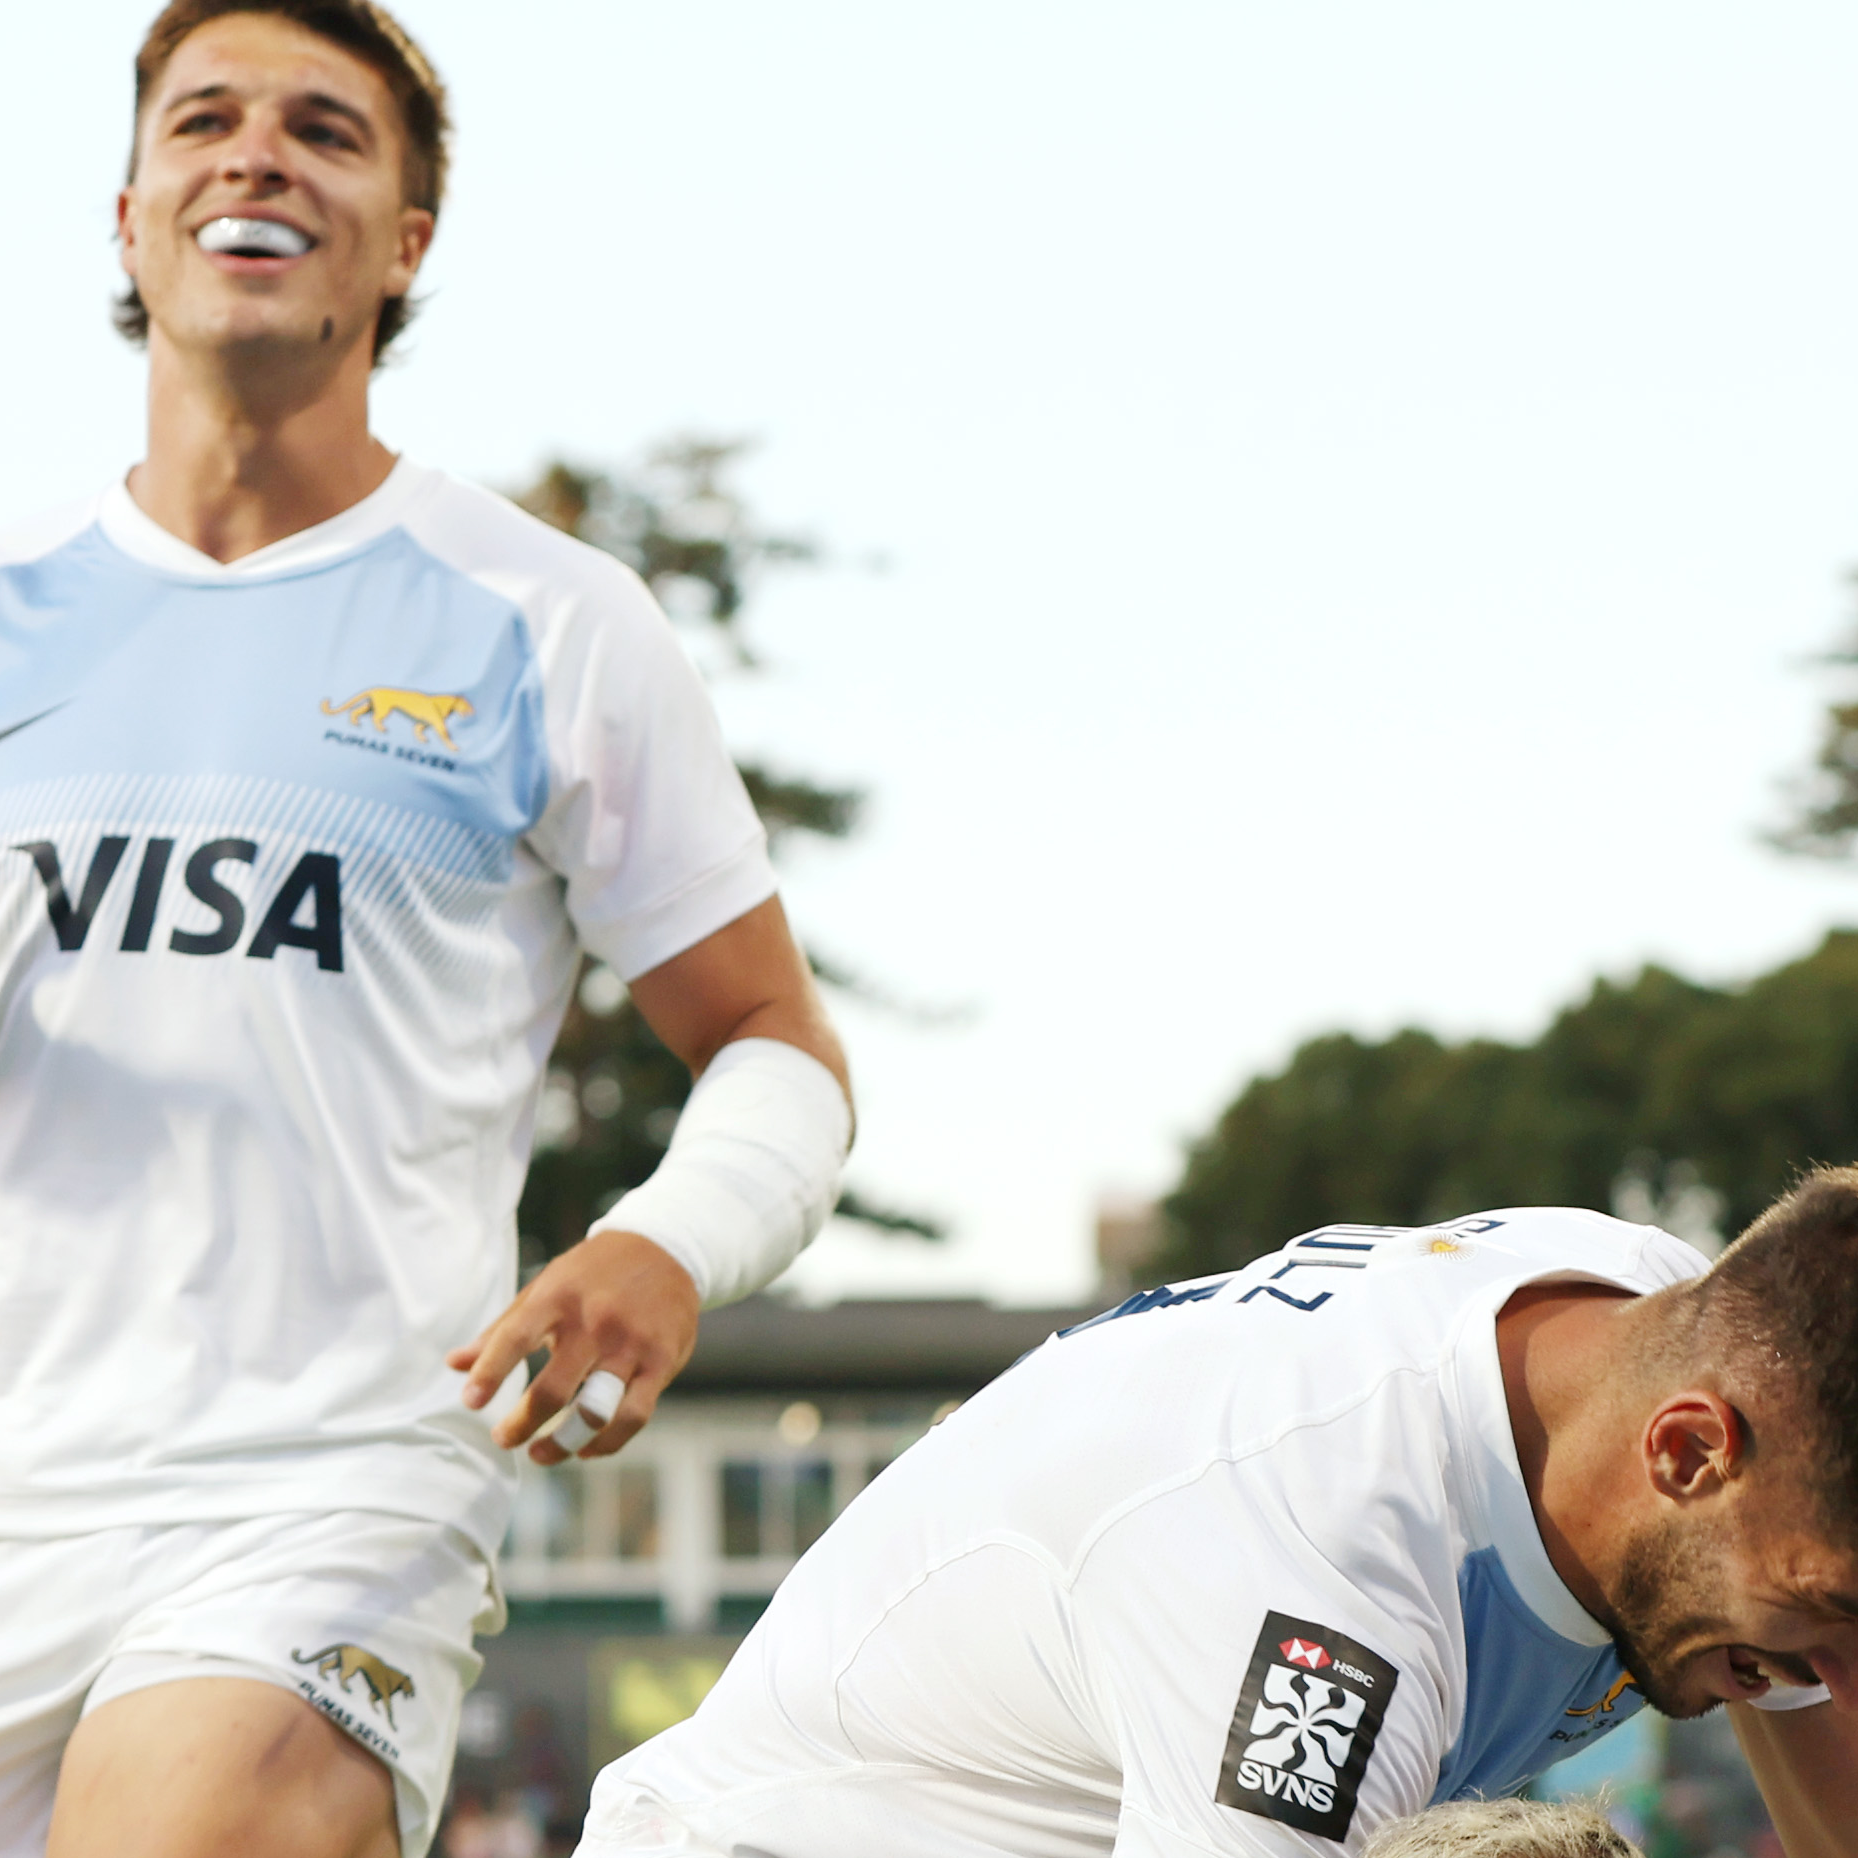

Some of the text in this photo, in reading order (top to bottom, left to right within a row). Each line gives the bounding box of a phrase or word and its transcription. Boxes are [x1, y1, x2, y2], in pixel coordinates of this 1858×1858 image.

[324, 729, 455, 771] PUMAS SEVEN
[8, 834, 345, 973] VISA
[1332, 1659, 1375, 1689] HSBC
[299, 1681, 399, 1760] PUMAS SEVEN
[1237, 1761, 1335, 1813] SVNS
